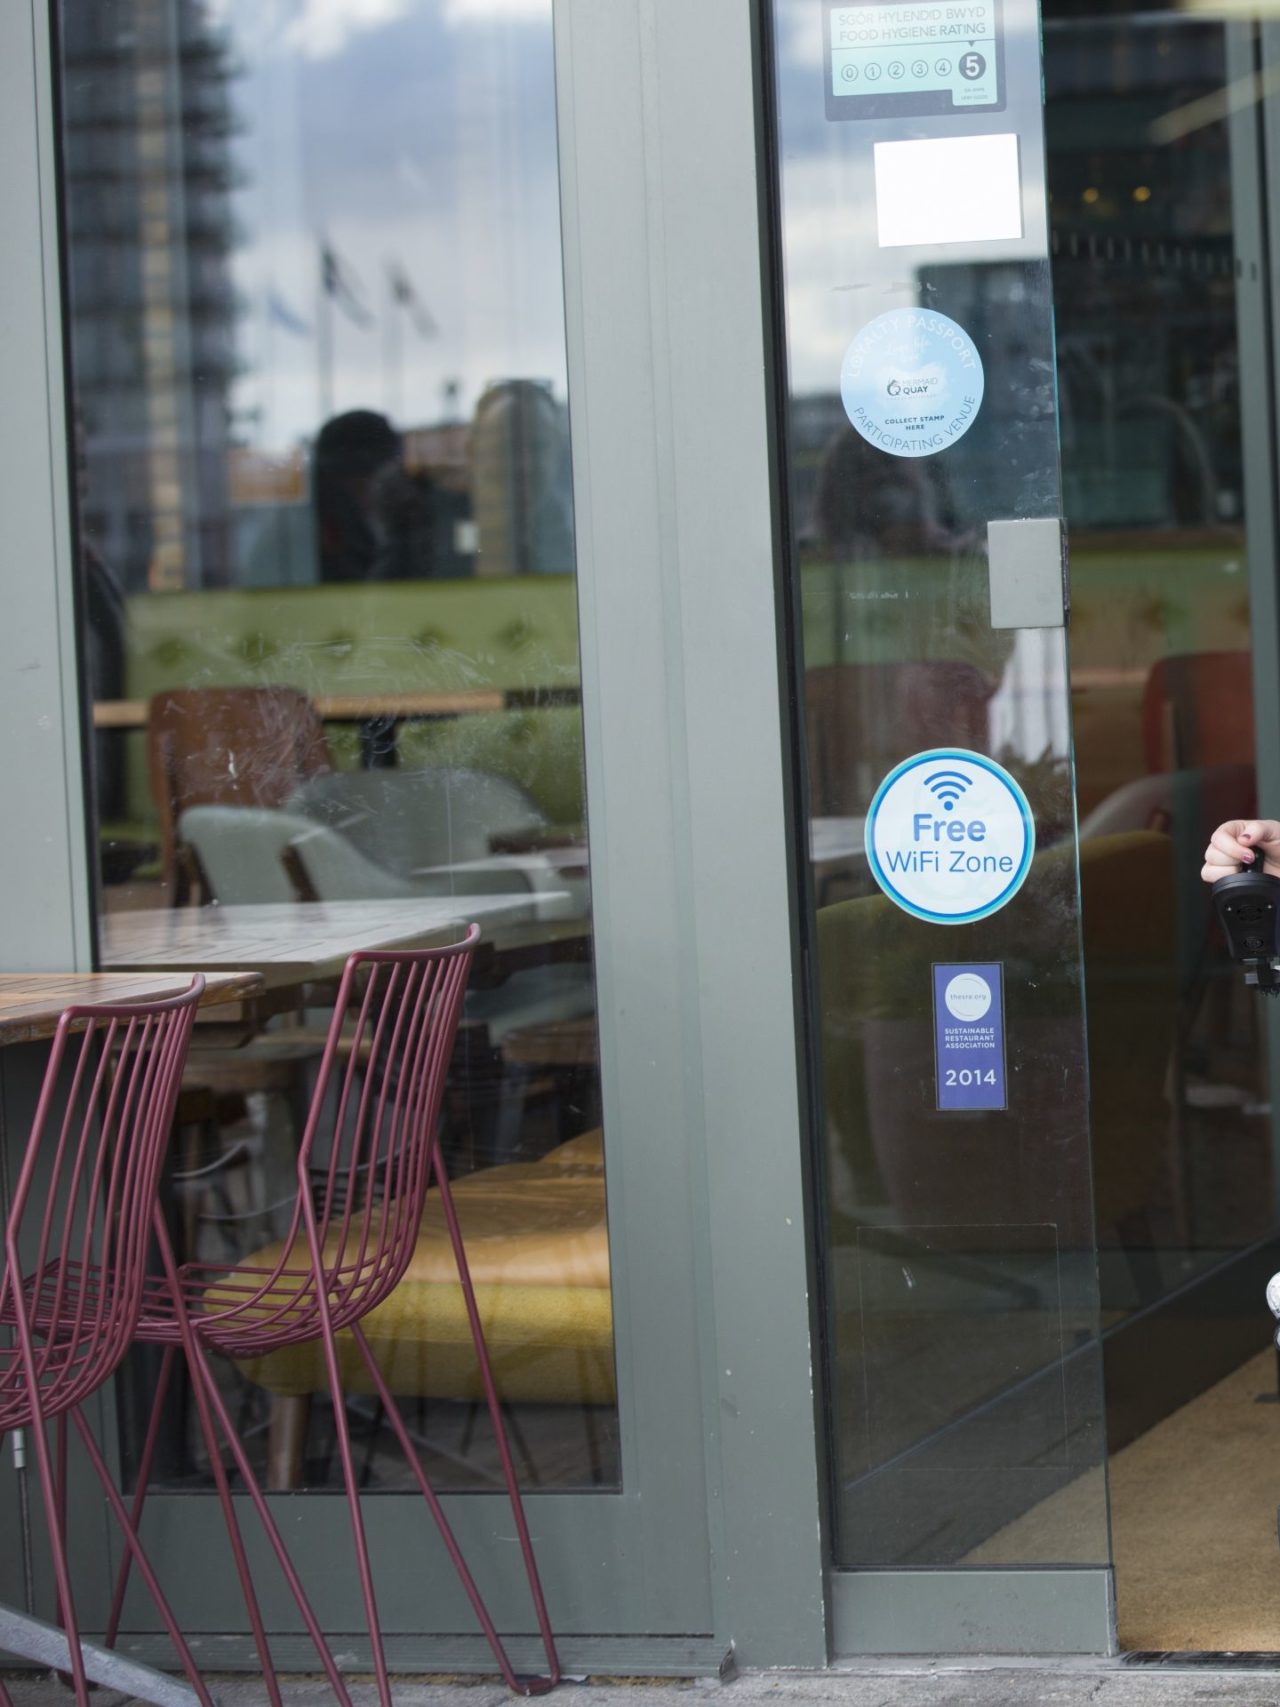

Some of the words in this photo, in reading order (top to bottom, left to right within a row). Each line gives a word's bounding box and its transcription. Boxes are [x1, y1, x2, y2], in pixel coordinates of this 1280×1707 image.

[878, 9, 942, 24] HYLENDID
[946, 6, 986, 20] BWYD
[839, 29, 879, 42] FOOD
[882, 25, 937, 41] HYGIENE
[940, 22, 986, 36] RATING
[965, 55, 979, 77] 5
[848, 317, 900, 377] LOYALTY
[908, 314, 977, 369] PASSPORT
[903, 385, 928, 395] QUAY
[853, 407, 944, 451] PARTICIPATING
[944, 394, 976, 437] VENUE
[884, 417, 918, 425] COLLECT
[913, 813, 986, 842] Free
[886, 851, 939, 873] WiFi
[949, 851, 1014, 873] Zone
[945, 1069, 997, 1086] 2014
